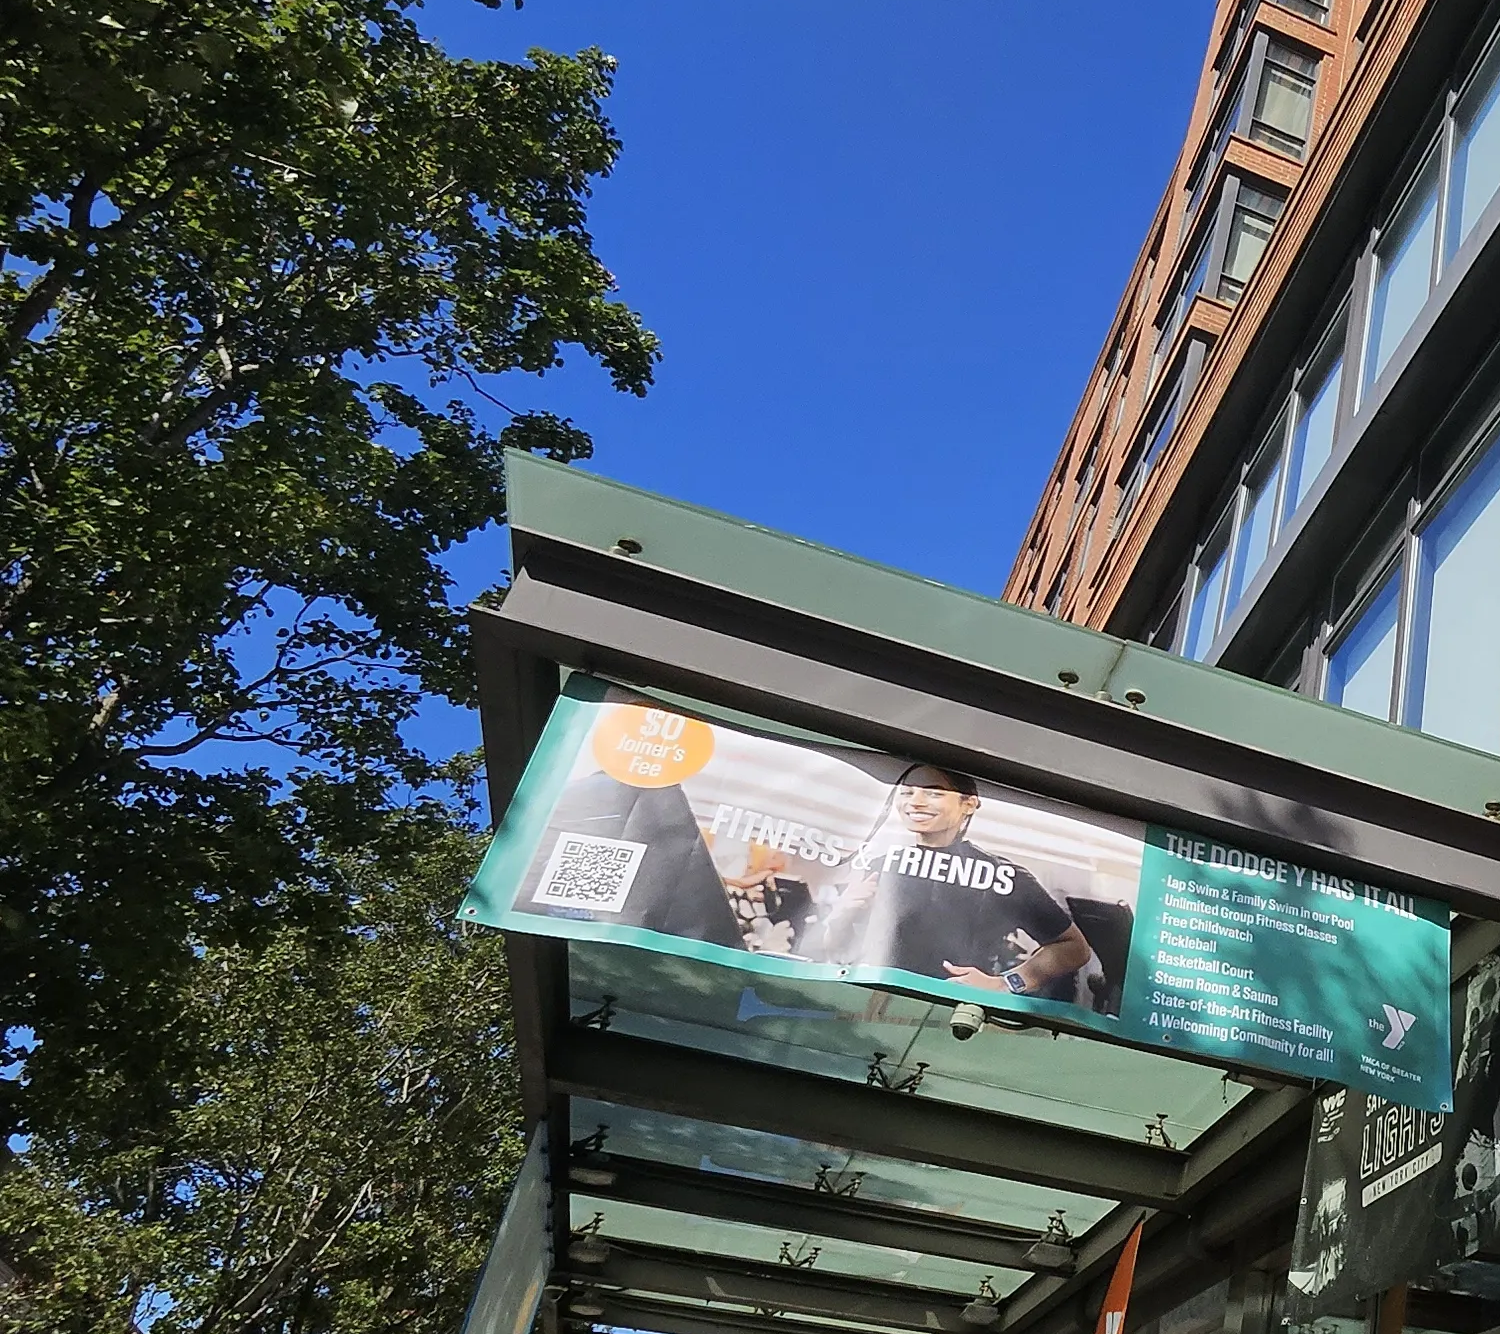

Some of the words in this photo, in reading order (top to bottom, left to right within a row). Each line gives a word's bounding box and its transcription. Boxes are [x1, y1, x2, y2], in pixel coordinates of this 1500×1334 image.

[639, 708, 687, 741] $0
[616, 734, 686, 762] Joiner's
[628, 755, 662, 777] Fee
[709, 804, 844, 868] FITNESS
[851, 842, 879, 872] &
[882, 844, 1017, 896] FRIENDS
[1166, 833, 1206, 865] THE
[1210, 844, 1288, 884] DODGE
[1292, 865, 1307, 887] Y
[1311, 869, 1356, 902] HAS
[1364, 884, 1382, 909] IT
[1385, 890, 1418, 922] ALL
[1166, 874, 1187, 895] Lap
[1187, 878, 1220, 899] Swim
[1221, 888, 1230, 902] &
[1231, 890, 1267, 911] Family
[1268, 898, 1300, 917] Swim
[1301, 906, 1311, 919] in
[1311, 910, 1331, 925] our
[1331, 914, 1355, 932] Pool
[1162, 912, 1188, 930] Free
[1189, 917, 1254, 943] Childwatch
[1164, 893, 1219, 916] Unlimited
[1220, 906, 1254, 926] Group
[1256, 913, 1296, 934] Fitness
[1296, 923, 1338, 945] Classes
[1159, 930, 1217, 954] Pickleball
[1157, 951, 1220, 974] Basketball
[1221, 964, 1255, 982] Court
[1154, 970, 1194, 990] Steam
[1195, 978, 1230, 997] Room
[1231, 984, 1241, 998] &
[1242, 987, 1279, 1007] Sauna
[1152, 991, 1250, 1021] State-of-the-Art
[1252, 1009, 1292, 1033] Fitness
[1293, 1018, 1334, 1044] Facility
[1368, 1018, 1385, 1032] the
[1148, 1012, 1159, 1027] A
[1161, 1014, 1229, 1042] Welcoming
[1230, 1026, 1296, 1058] Community
[1297, 1042, 1314, 1059] for
[1315, 1047, 1335, 1064] all!
[1359, 1064, 1376, 1076] NEW
[1376, 1071, 1396, 1083] YORK
[1361, 1054, 1381, 1068] YMCA
[1381, 1062, 1391, 1071] OF
[1391, 1066, 1422, 1083] GREATER
[1389, 1168, 1409, 1186] YORK
